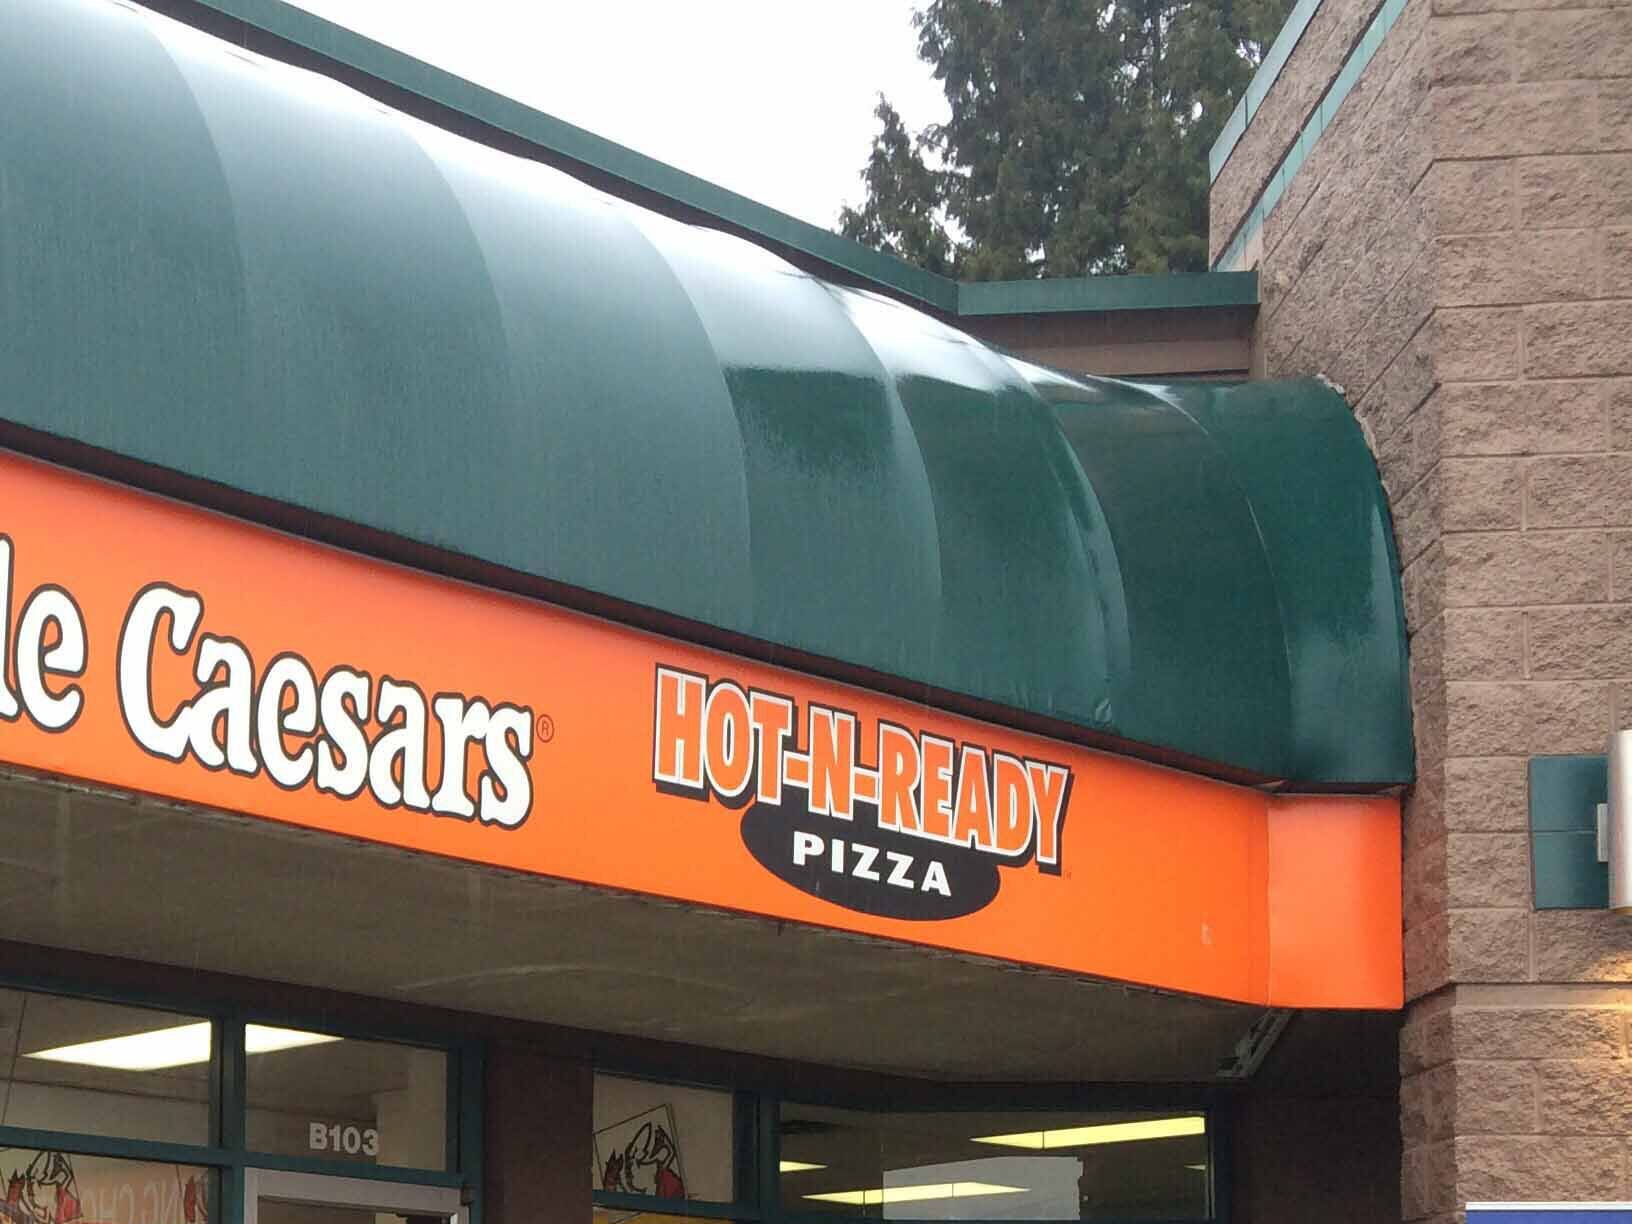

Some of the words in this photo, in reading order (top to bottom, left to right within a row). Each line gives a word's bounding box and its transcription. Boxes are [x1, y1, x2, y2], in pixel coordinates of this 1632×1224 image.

[119, 583, 534, 829] Caesars
[653, 664, 1072, 873] HOT-N-READY
[792, 831, 952, 897] PIZZA
[308, 1121, 380, 1157] B103
